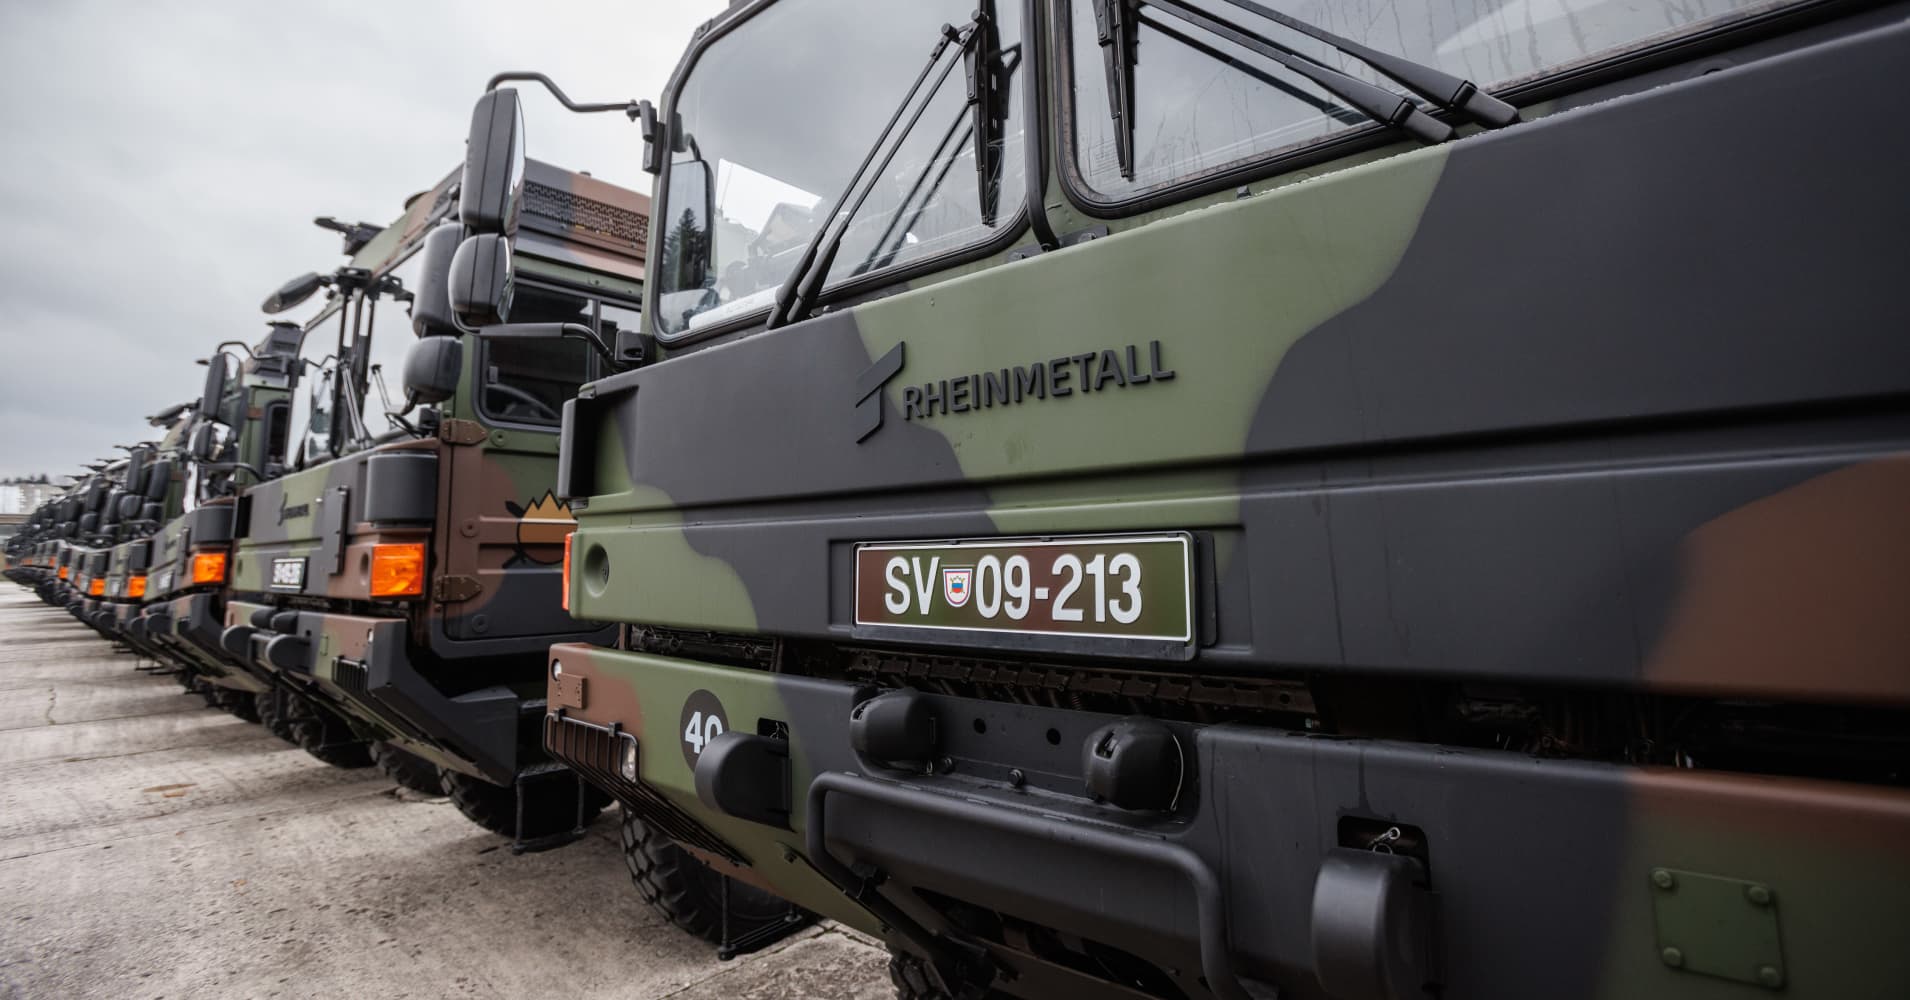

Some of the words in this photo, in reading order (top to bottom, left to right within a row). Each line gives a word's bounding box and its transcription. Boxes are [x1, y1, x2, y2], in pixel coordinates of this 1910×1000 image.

[902, 340, 1175, 421] RHEINMETALL
[885, 556, 940, 616] SV
[975, 552, 1143, 624] 09-213
